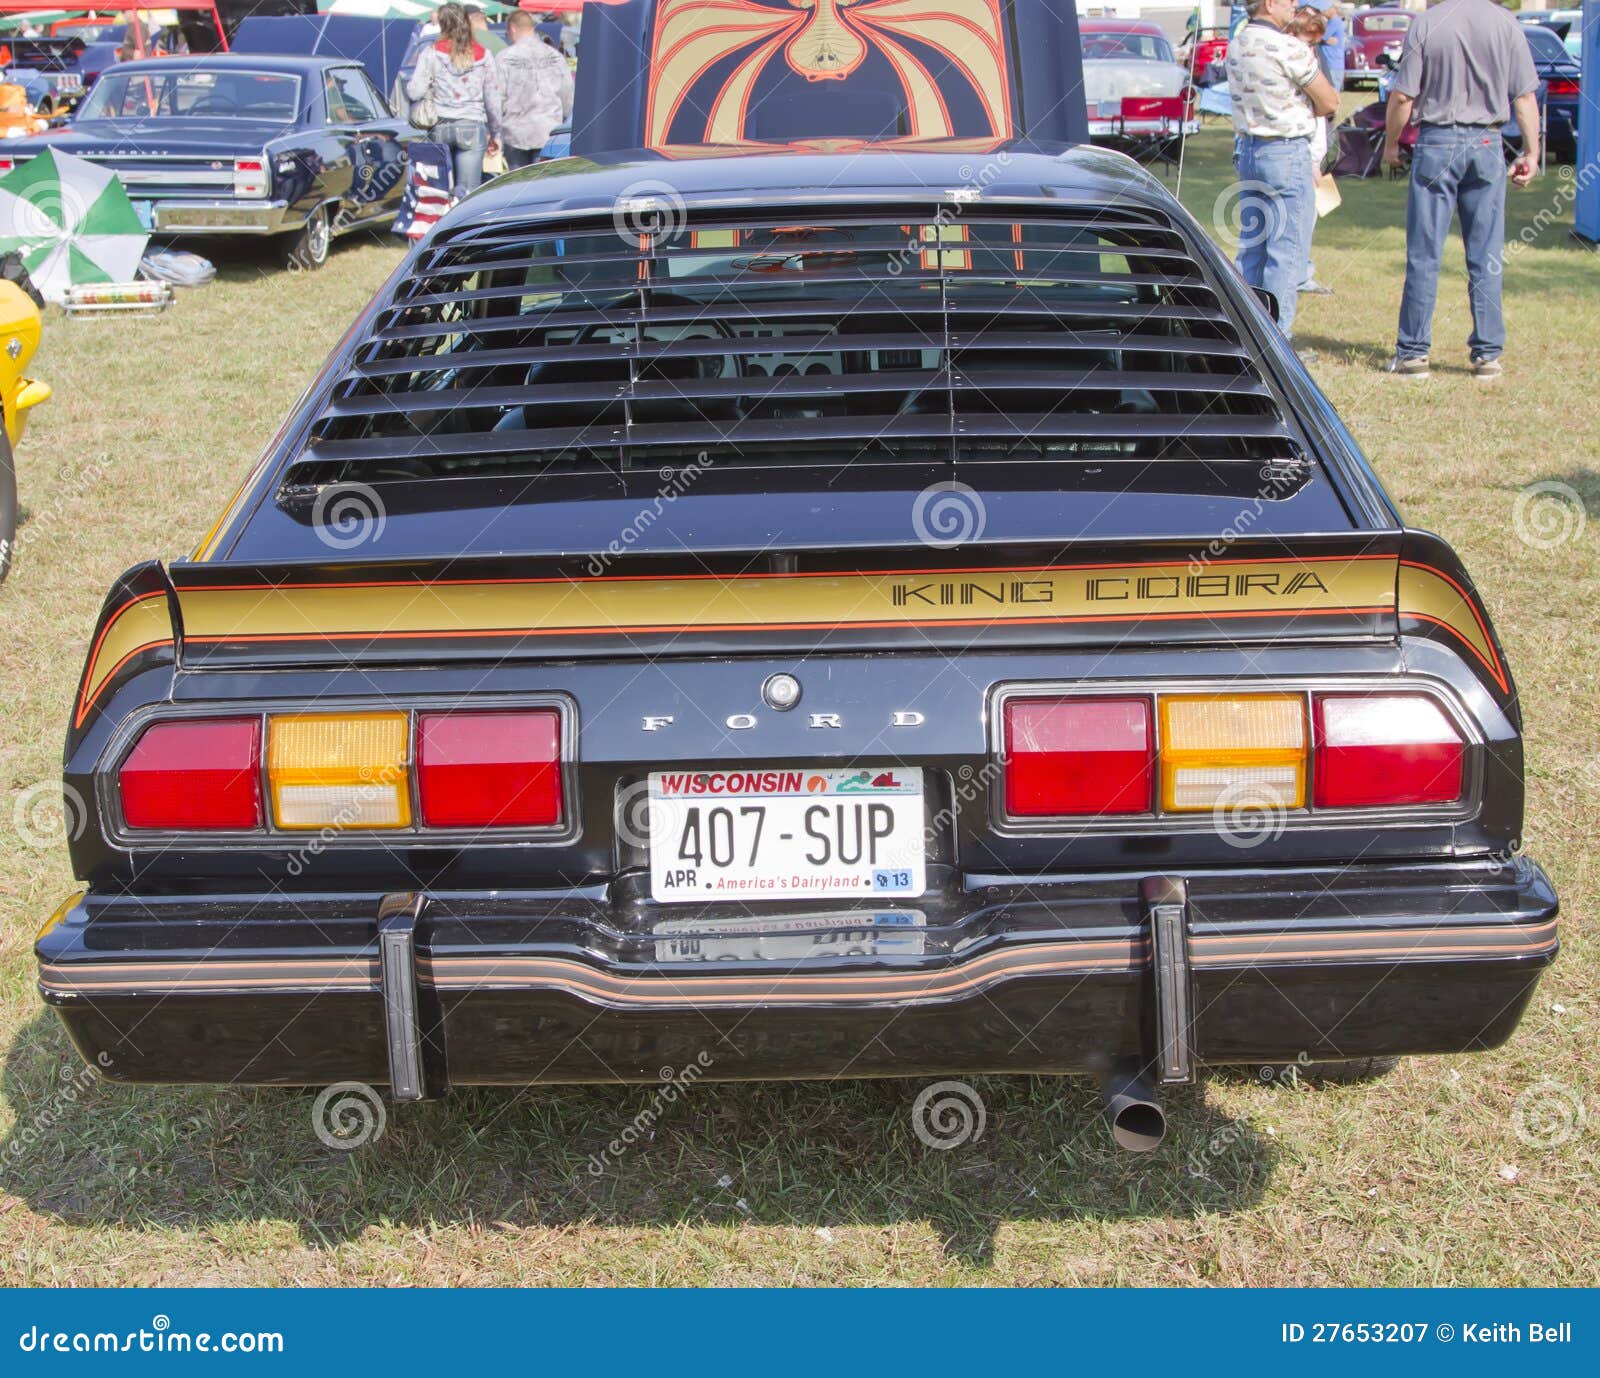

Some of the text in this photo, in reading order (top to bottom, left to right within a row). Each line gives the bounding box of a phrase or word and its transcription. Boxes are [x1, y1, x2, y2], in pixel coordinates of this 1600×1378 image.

[892, 572, 1329, 606] KING COBRA
[642, 711, 925, 731] FORD
[661, 772, 803, 794] WISCONSIN
[664, 869, 697, 888] APR
[716, 875, 860, 890] America's Dairyland
[892, 872, 909, 886] 13
